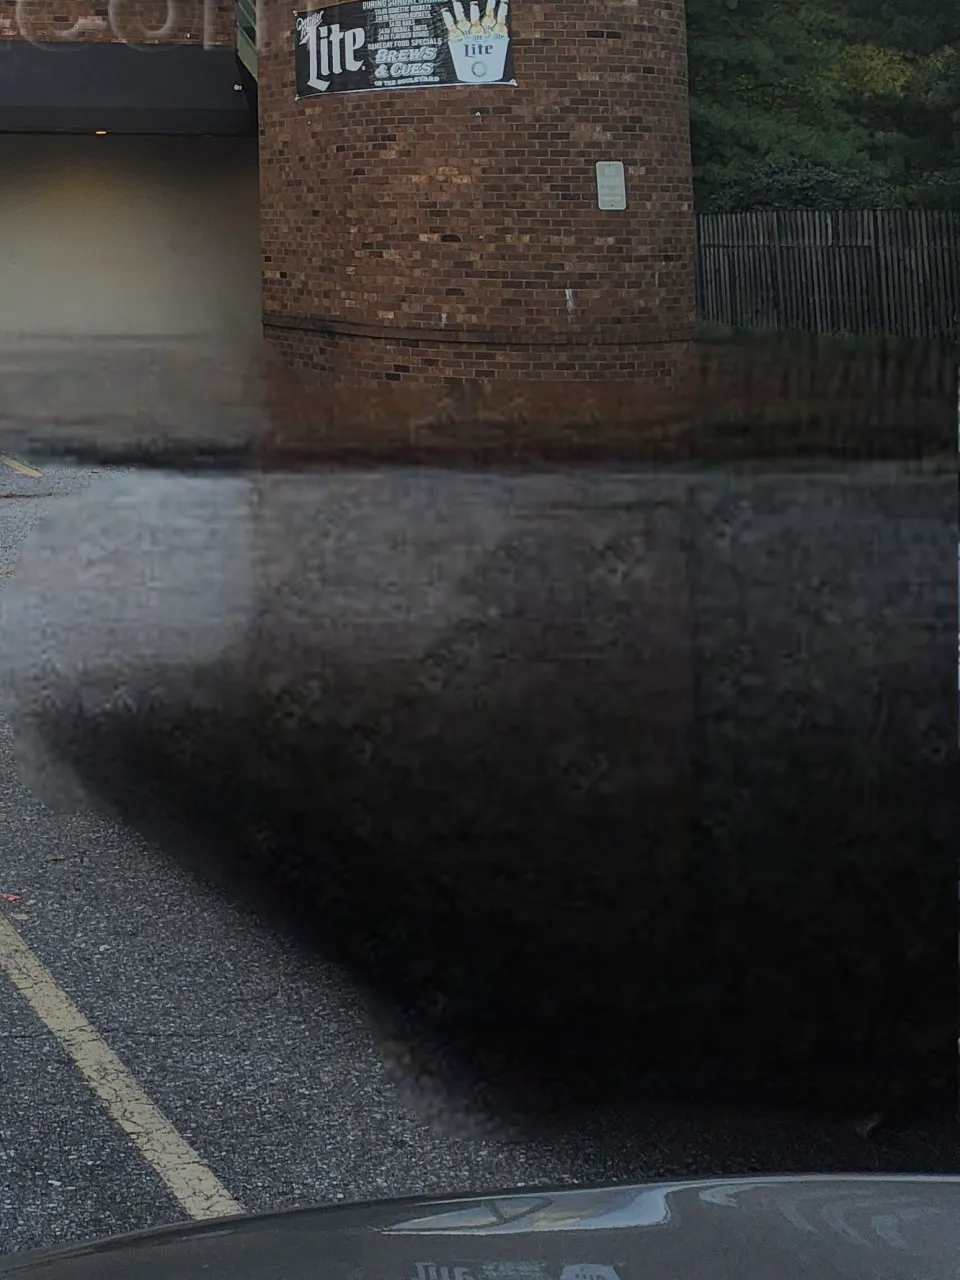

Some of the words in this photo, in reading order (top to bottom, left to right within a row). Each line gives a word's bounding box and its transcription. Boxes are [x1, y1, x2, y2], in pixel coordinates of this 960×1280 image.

[394, 39, 410, 47] FOOD
[411, 37, 442, 46] SPECIALS
[306, 23, 366, 92] Lite
[464, 43, 493, 58] Lite
[374, 63, 389, 78] &
[390, 62, 435, 77] CUES
